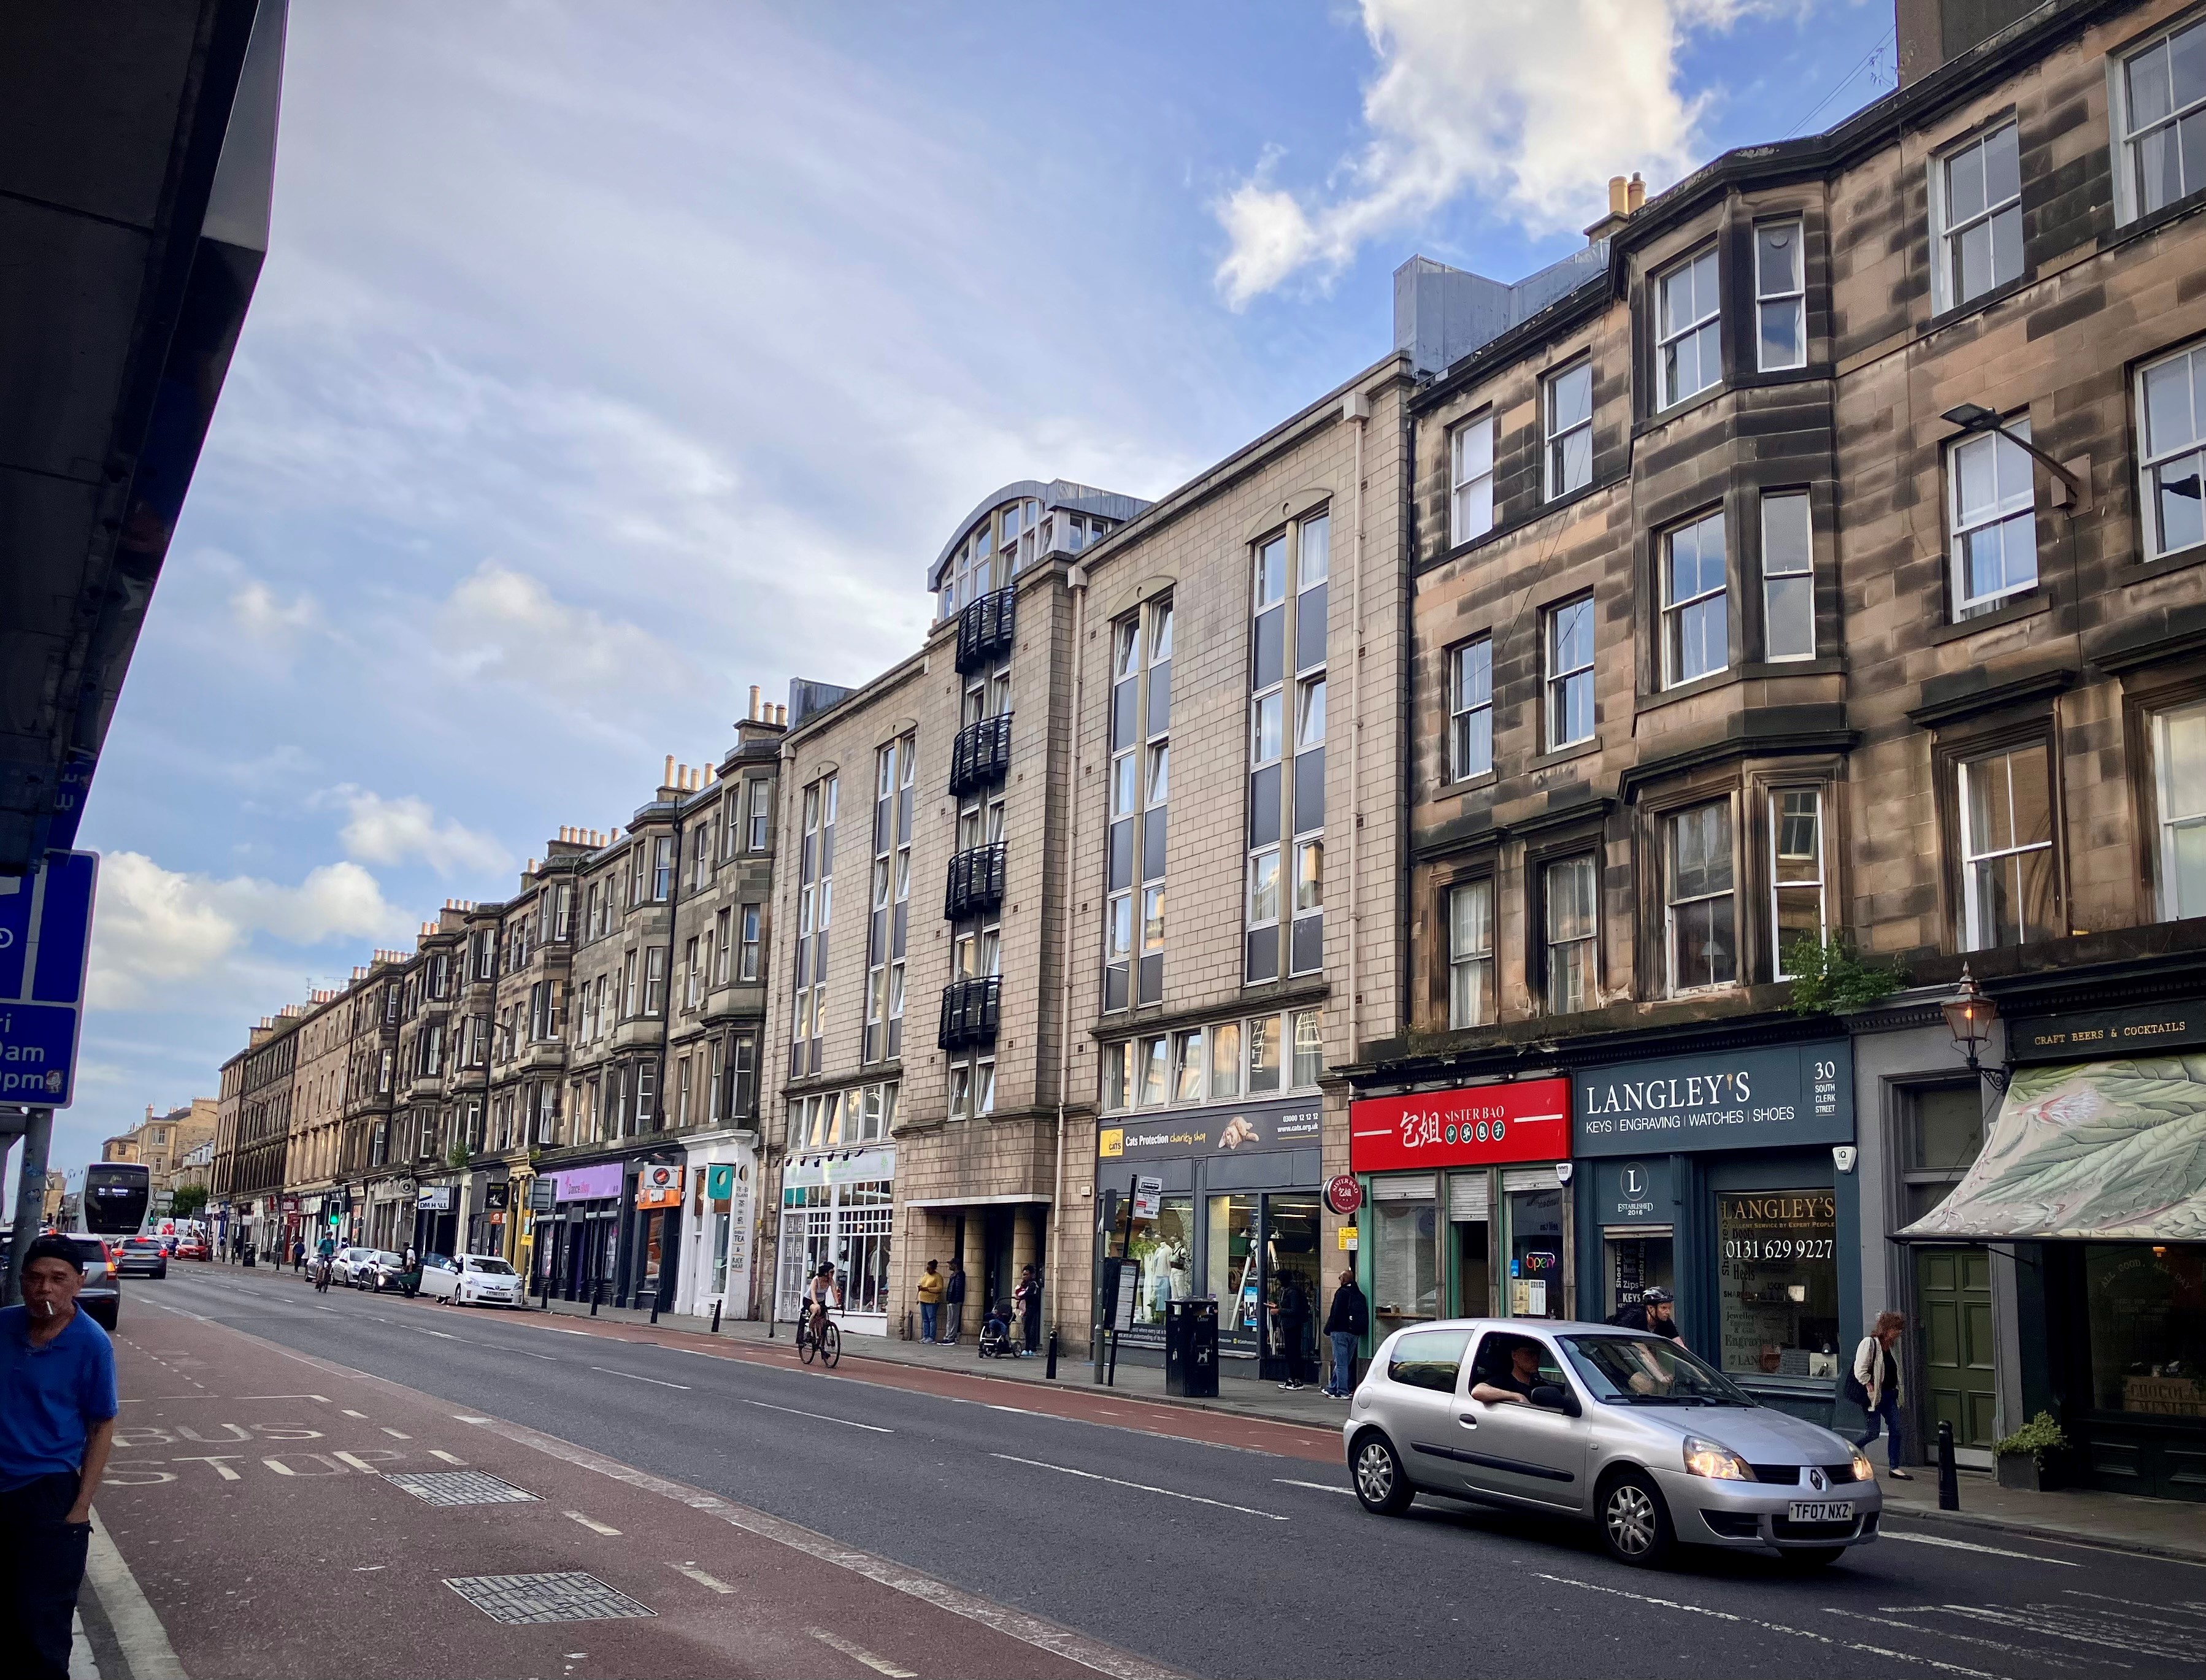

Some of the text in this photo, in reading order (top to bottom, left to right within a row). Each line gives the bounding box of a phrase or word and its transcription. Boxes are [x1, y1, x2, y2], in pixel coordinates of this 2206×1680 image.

[2035, 1034, 2065, 1045] CRAFT
[2072, 1030, 2104, 1041] BEERS
[2124, 1021, 2185, 1036] COCKTAILS
[1815, 1061, 1835, 1080] 30
[1586, 1071, 1751, 1114] LANGLEY'S
[1815, 1084, 1835, 1093] SOUTH
[1815, 1094, 1836, 1103] CLERK
[1445, 1105, 1504, 1122] SISTER BAO
[1815, 1105, 1835, 1113] STREET
[1277, 1122, 1318, 1133] www.cats.org.uk
[1585, 1106, 1795, 1133] KEYS ENGRAVING WATCHES SHOES
[1125, 1135, 1138, 1146] Cats
[1139, 1133, 1169, 1146] Protection
[1170, 1132, 1192, 1145] charity
[1332, 1178, 1358, 1194] SISTER BAO
[1628, 1170, 1642, 1192] L
[1723, 1197, 1835, 1219] LANGLEY'S
[1726, 1239, 1833, 1259] 0131 629 9227
[1734, 1264, 1755, 1281] Heels
[1623, 1281, 1639, 1290] Zips
[1623, 1293, 1641, 1303] KEYS
[110, 1423, 326, 1448] BUS
[102, 1449, 407, 1485] STOP
[1795, 1504, 1848, 1519] TF07 NXZ
